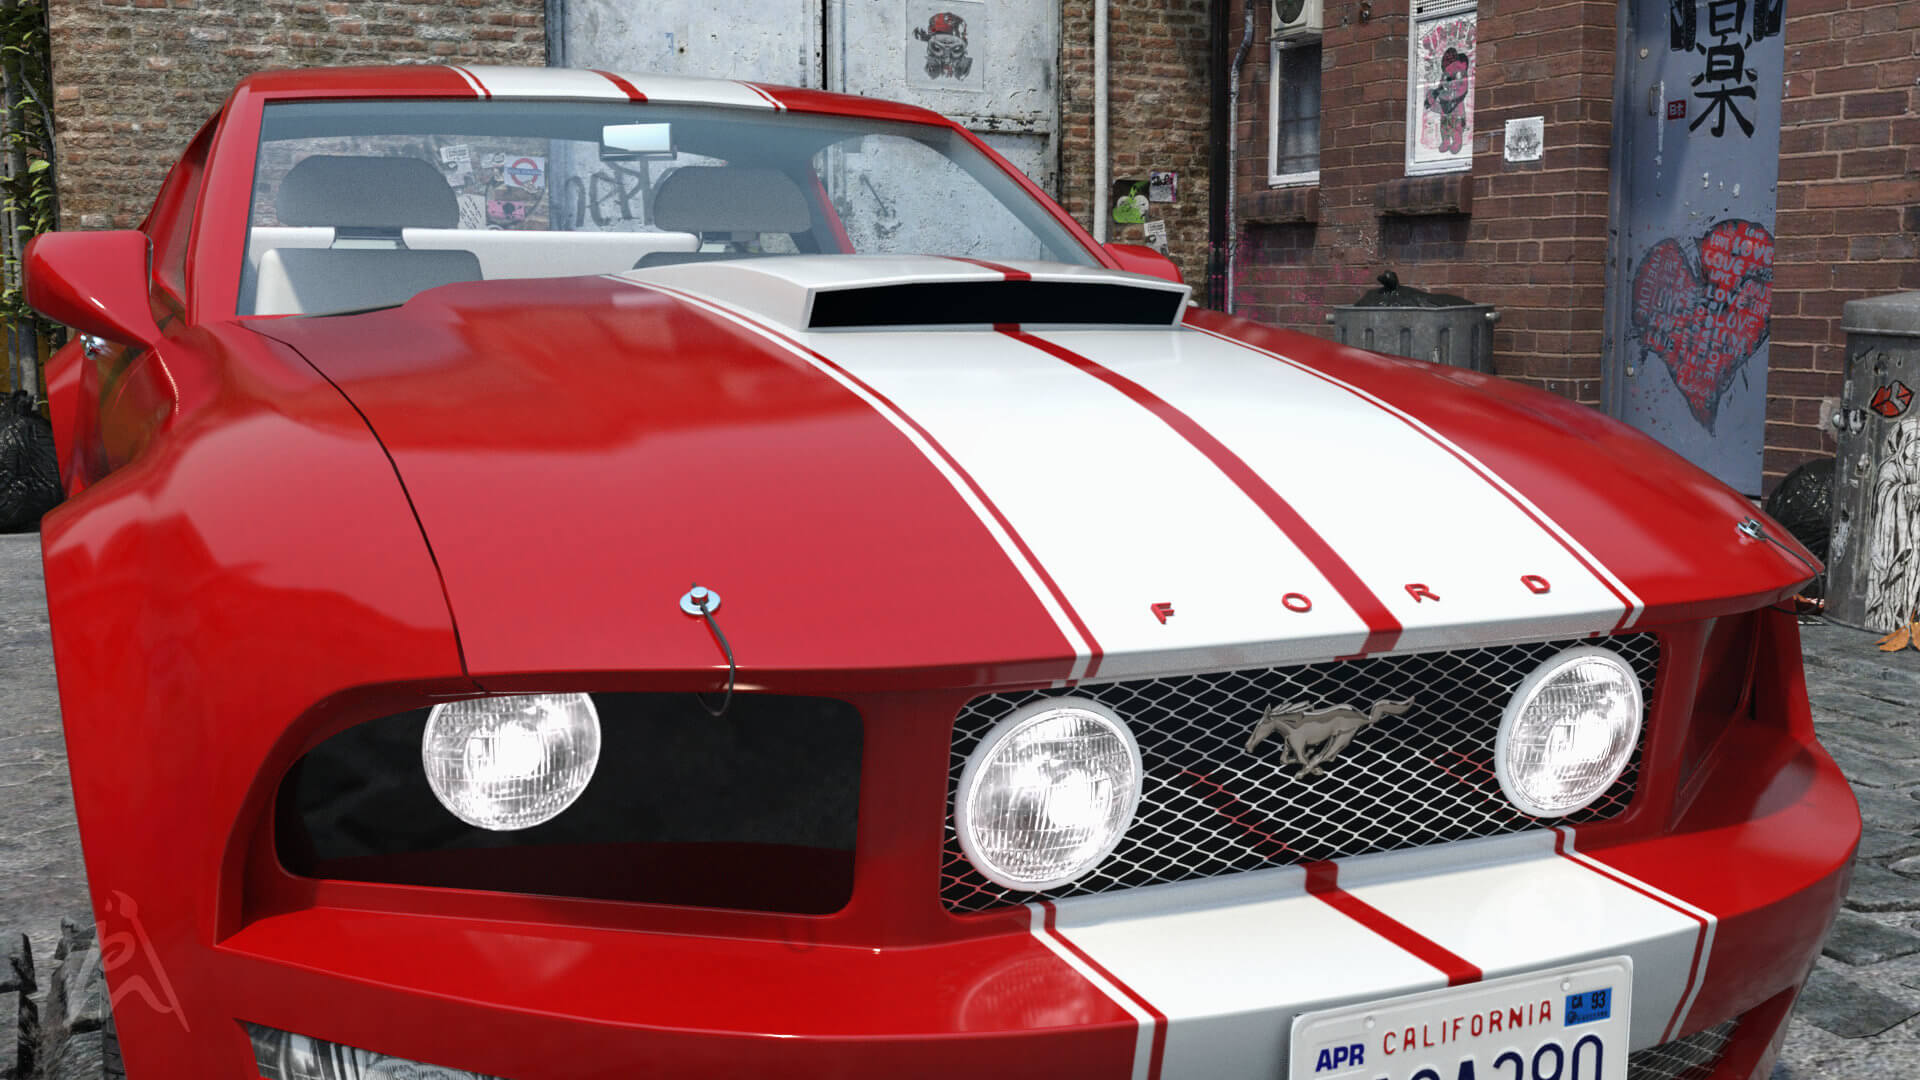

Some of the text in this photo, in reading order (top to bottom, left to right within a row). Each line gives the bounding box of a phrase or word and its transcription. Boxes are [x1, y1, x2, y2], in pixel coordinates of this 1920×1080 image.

[1704, 250, 1745, 276] LOVE
[1732, 236, 1775, 265] LOVE
[1706, 284, 1746, 309] LOVE
[1592, 991, 1606, 1009] 93
[1383, 1000, 1552, 1055] CALIFORNIA
[1315, 1043, 1364, 1072] APR
